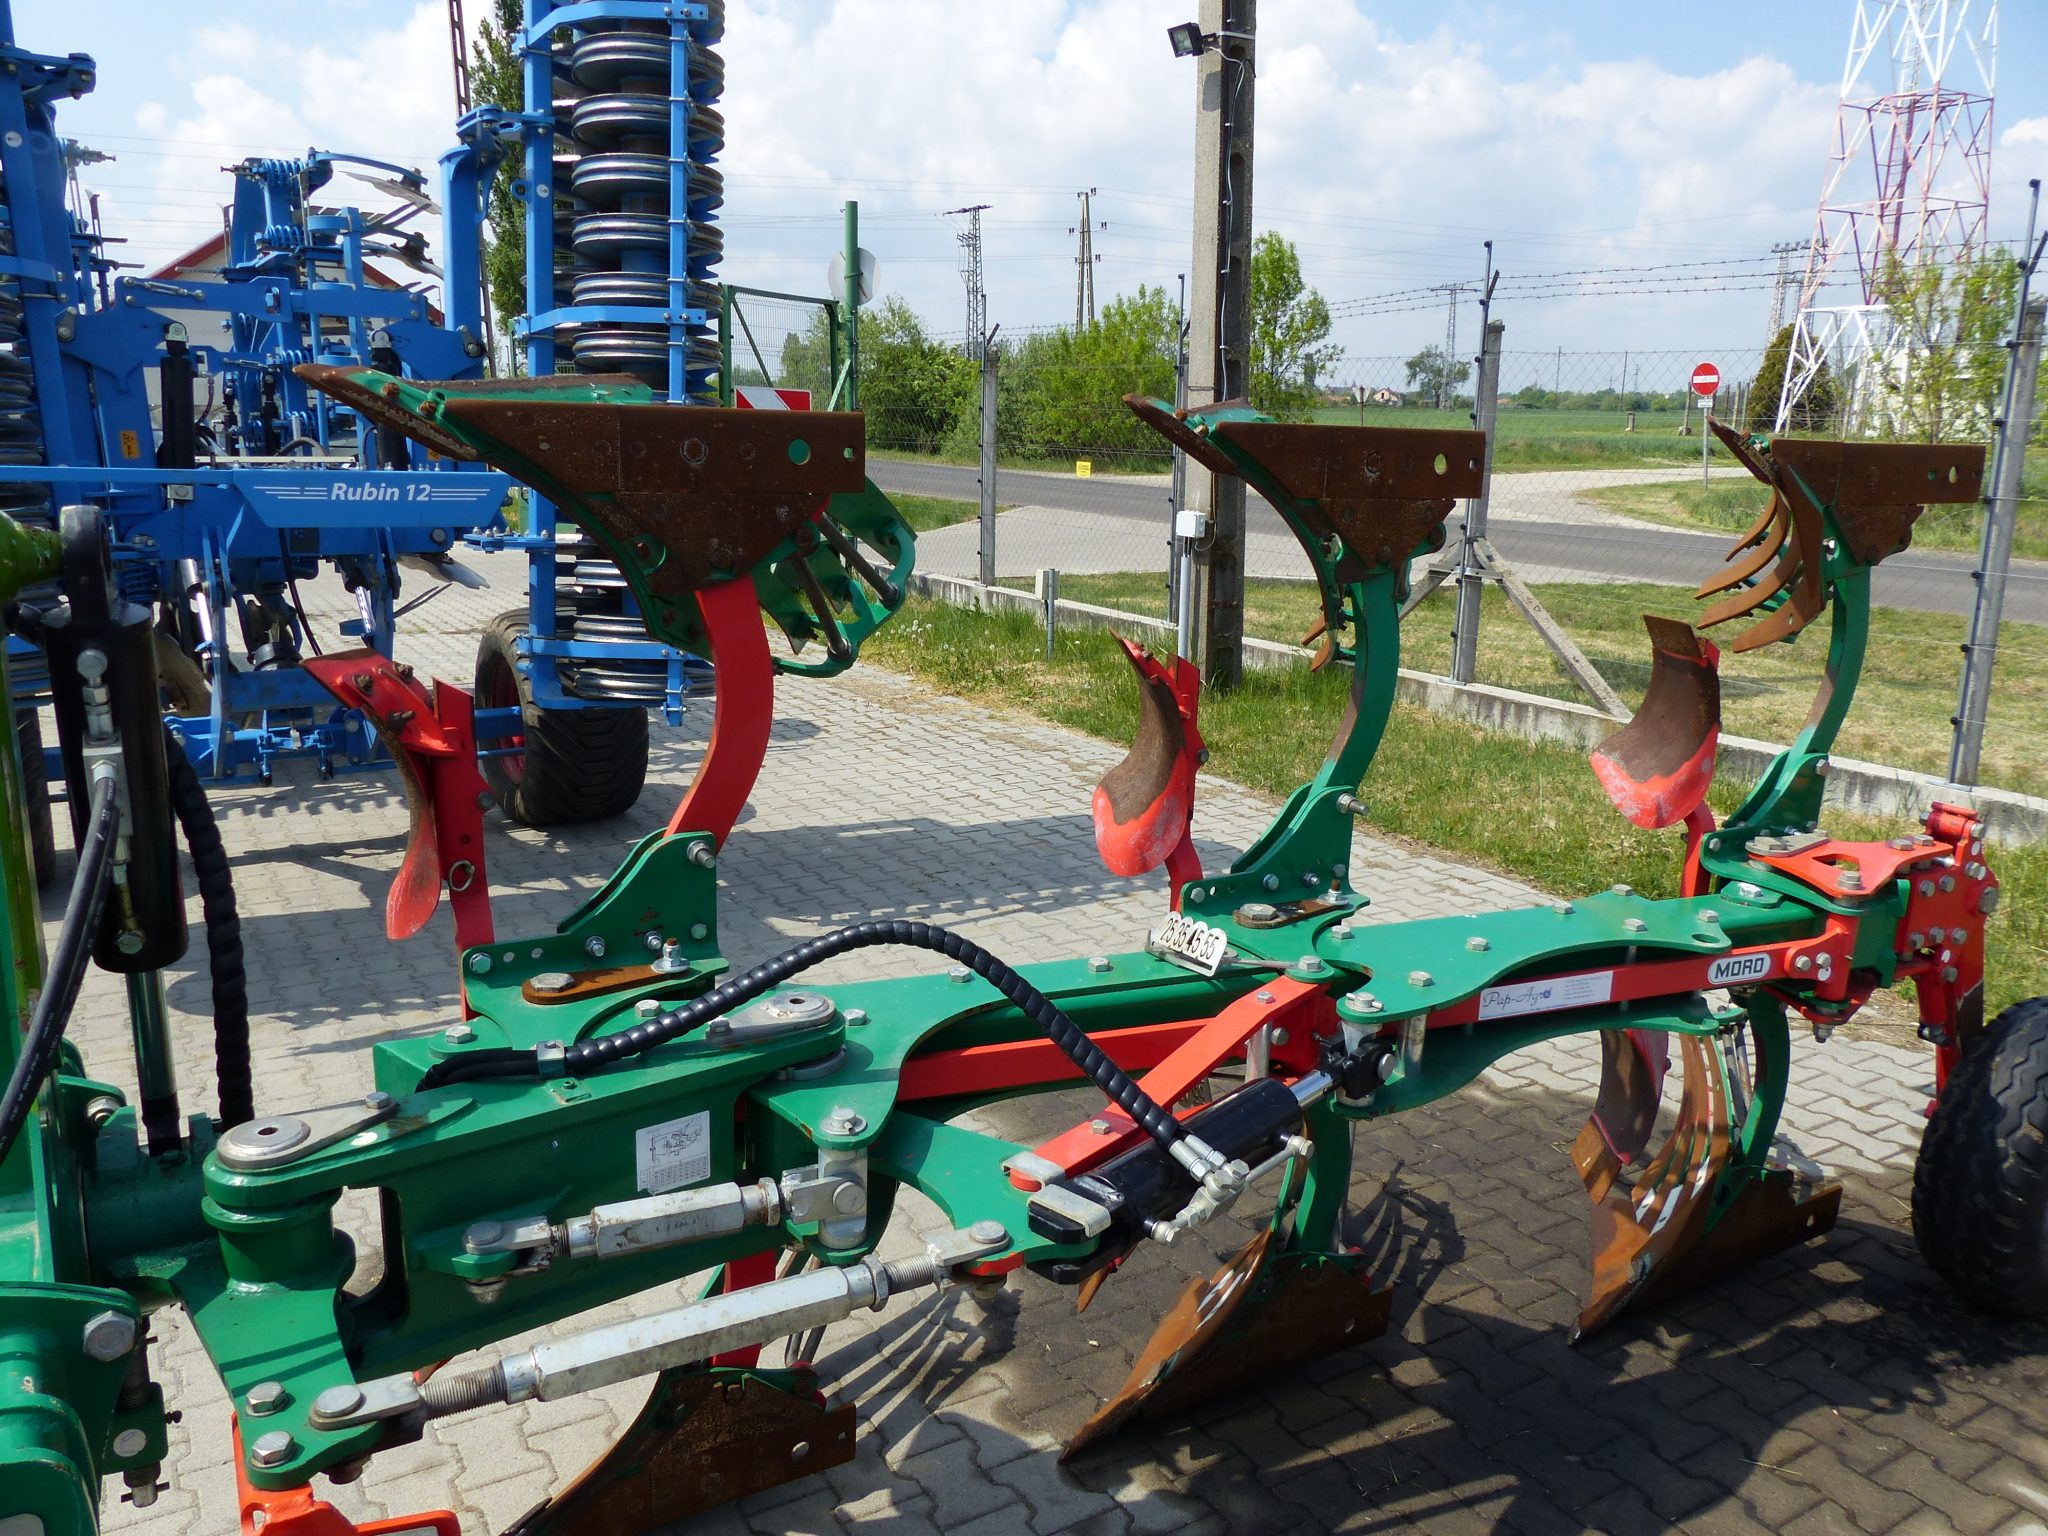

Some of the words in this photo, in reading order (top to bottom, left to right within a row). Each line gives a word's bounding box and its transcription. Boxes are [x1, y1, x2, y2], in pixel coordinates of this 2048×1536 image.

[331, 482, 400, 501] Rubin
[406, 484, 431, 501] 12
[1160, 917, 1178, 943] 25
[1173, 922, 1191, 948] 35
[1186, 927, 1205, 954] 45
[1200, 933, 1219, 960] 55
[1715, 957, 1765, 979] MORO
